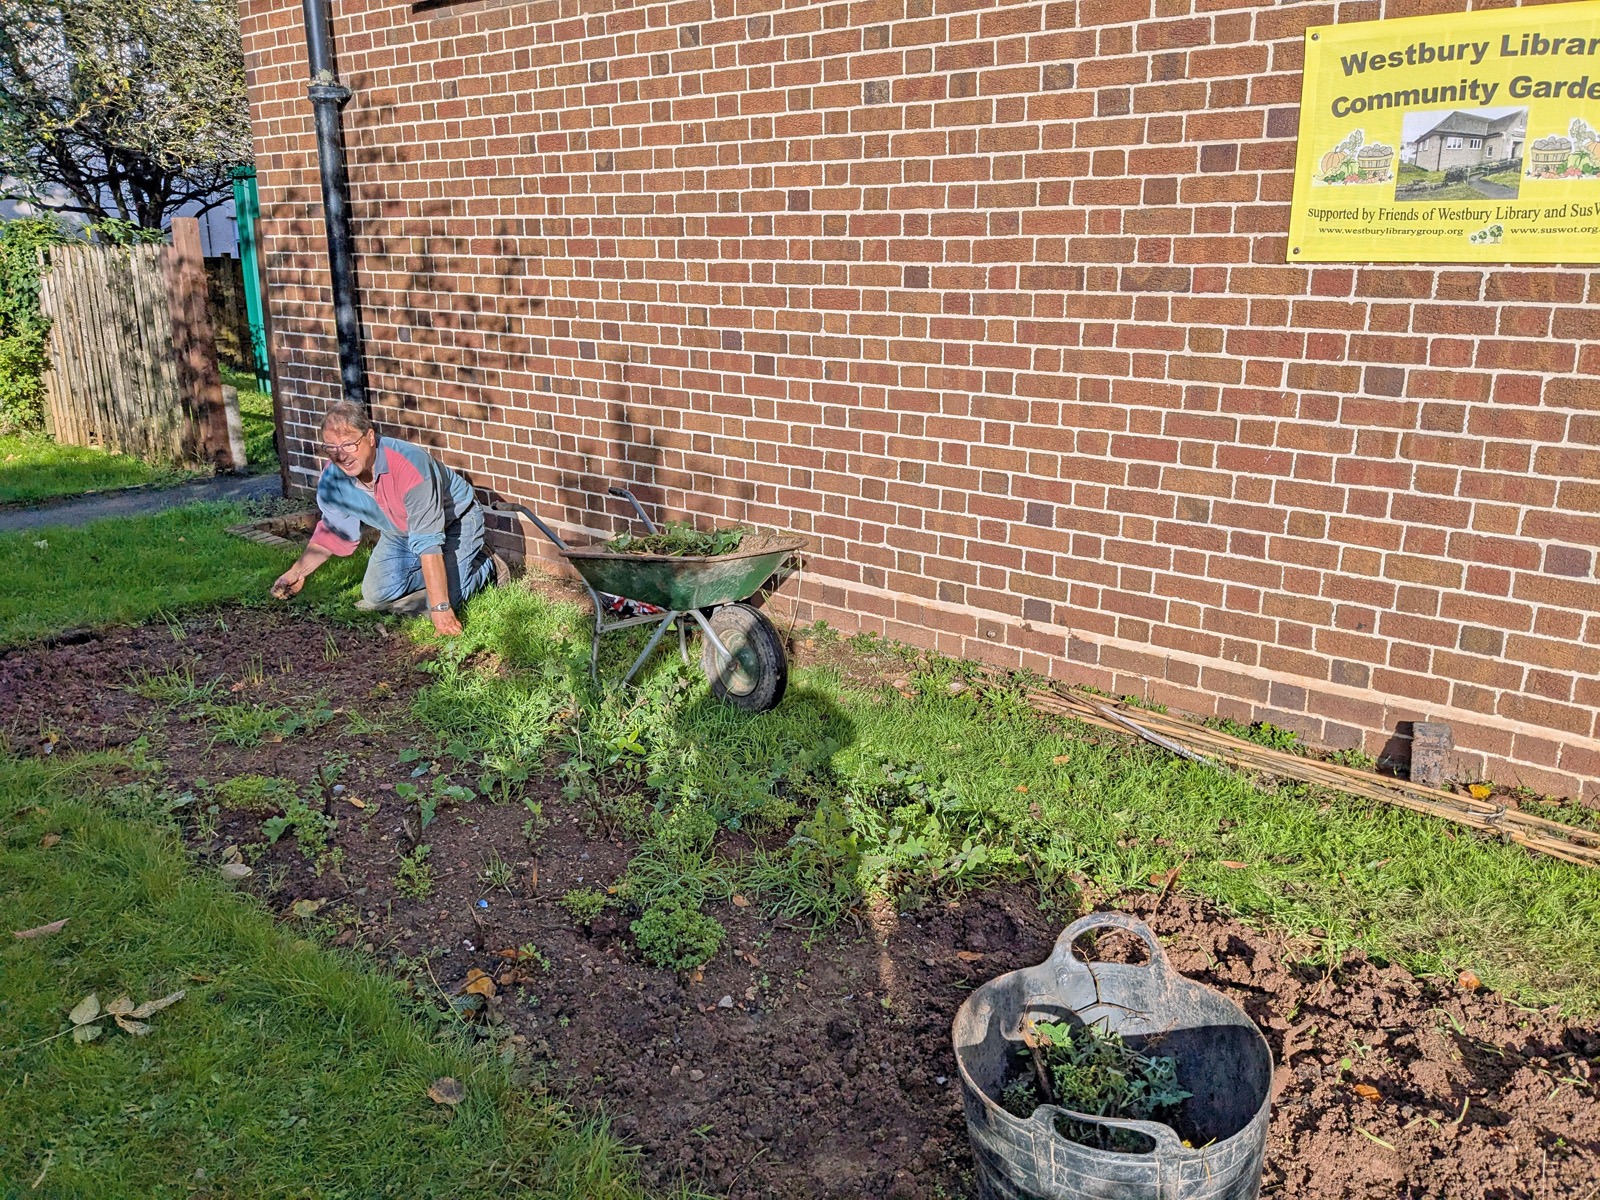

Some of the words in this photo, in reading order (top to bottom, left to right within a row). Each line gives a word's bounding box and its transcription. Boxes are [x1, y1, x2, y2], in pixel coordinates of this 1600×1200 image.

[1340, 41, 1490, 77] Westbury
[1500, 33, 1600, 57] Librar
[1331, 78, 1499, 118] Community
[1509, 75, 1600, 100] Garde
[1307, 207, 1359, 222] supported
[1362, 207, 1376, 224] by
[1378, 207, 1419, 221] Friends
[1422, 207, 1436, 221] of
[1438, 207, 1492, 224] Westbury
[1496, 205, 1541, 223] Library
[1544, 203, 1567, 219] and
[1318, 226, 1464, 237] www.westburylibrarygroup.org
